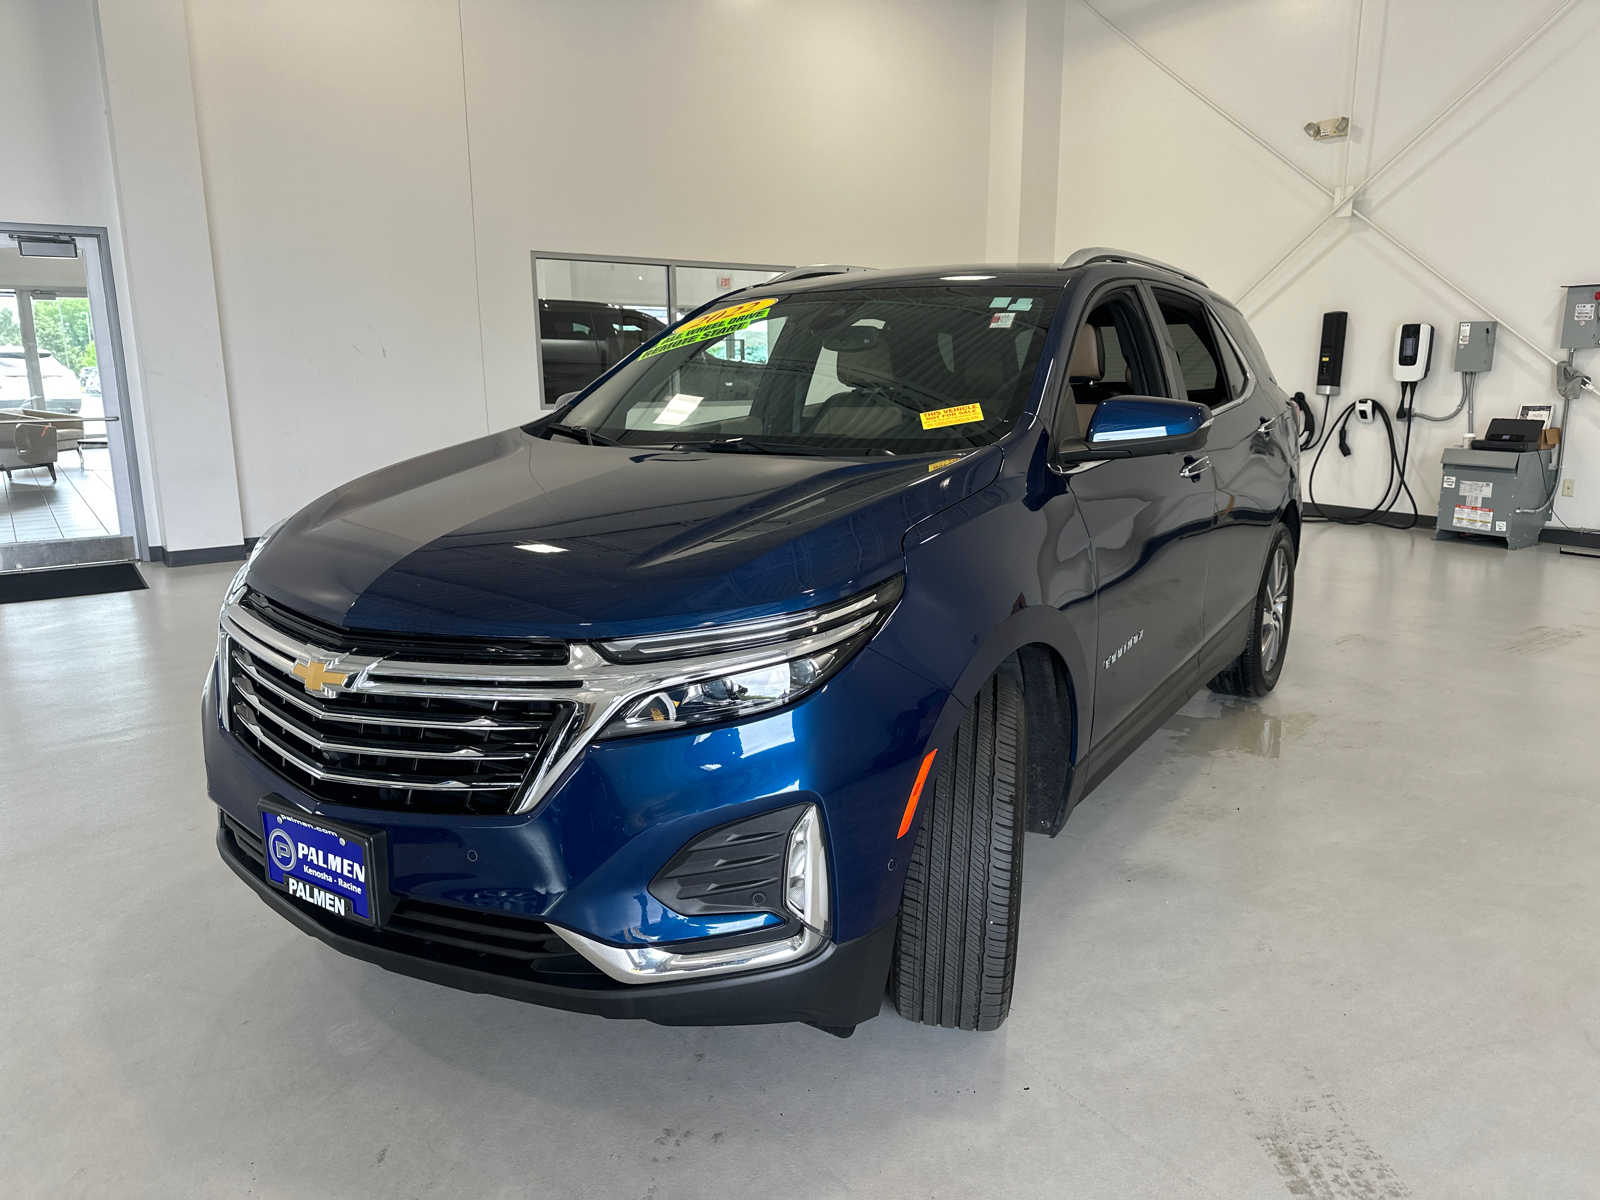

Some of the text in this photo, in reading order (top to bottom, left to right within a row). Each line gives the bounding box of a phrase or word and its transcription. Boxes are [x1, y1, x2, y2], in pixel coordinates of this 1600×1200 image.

[660, 309, 767, 346] ALL WHEEL DRIVE
[688, 301, 761, 330] 2022
[641, 321, 749, 359] REMOTE START
[943, 404, 978, 414] VEHICLE
[280, 814, 338, 837] palmen.com
[297, 842, 365, 883] PALMEN
[303, 864, 333, 883] Kenosha
[338, 877, 362, 895] Racine
[288, 877, 345, 916] PALMEN
